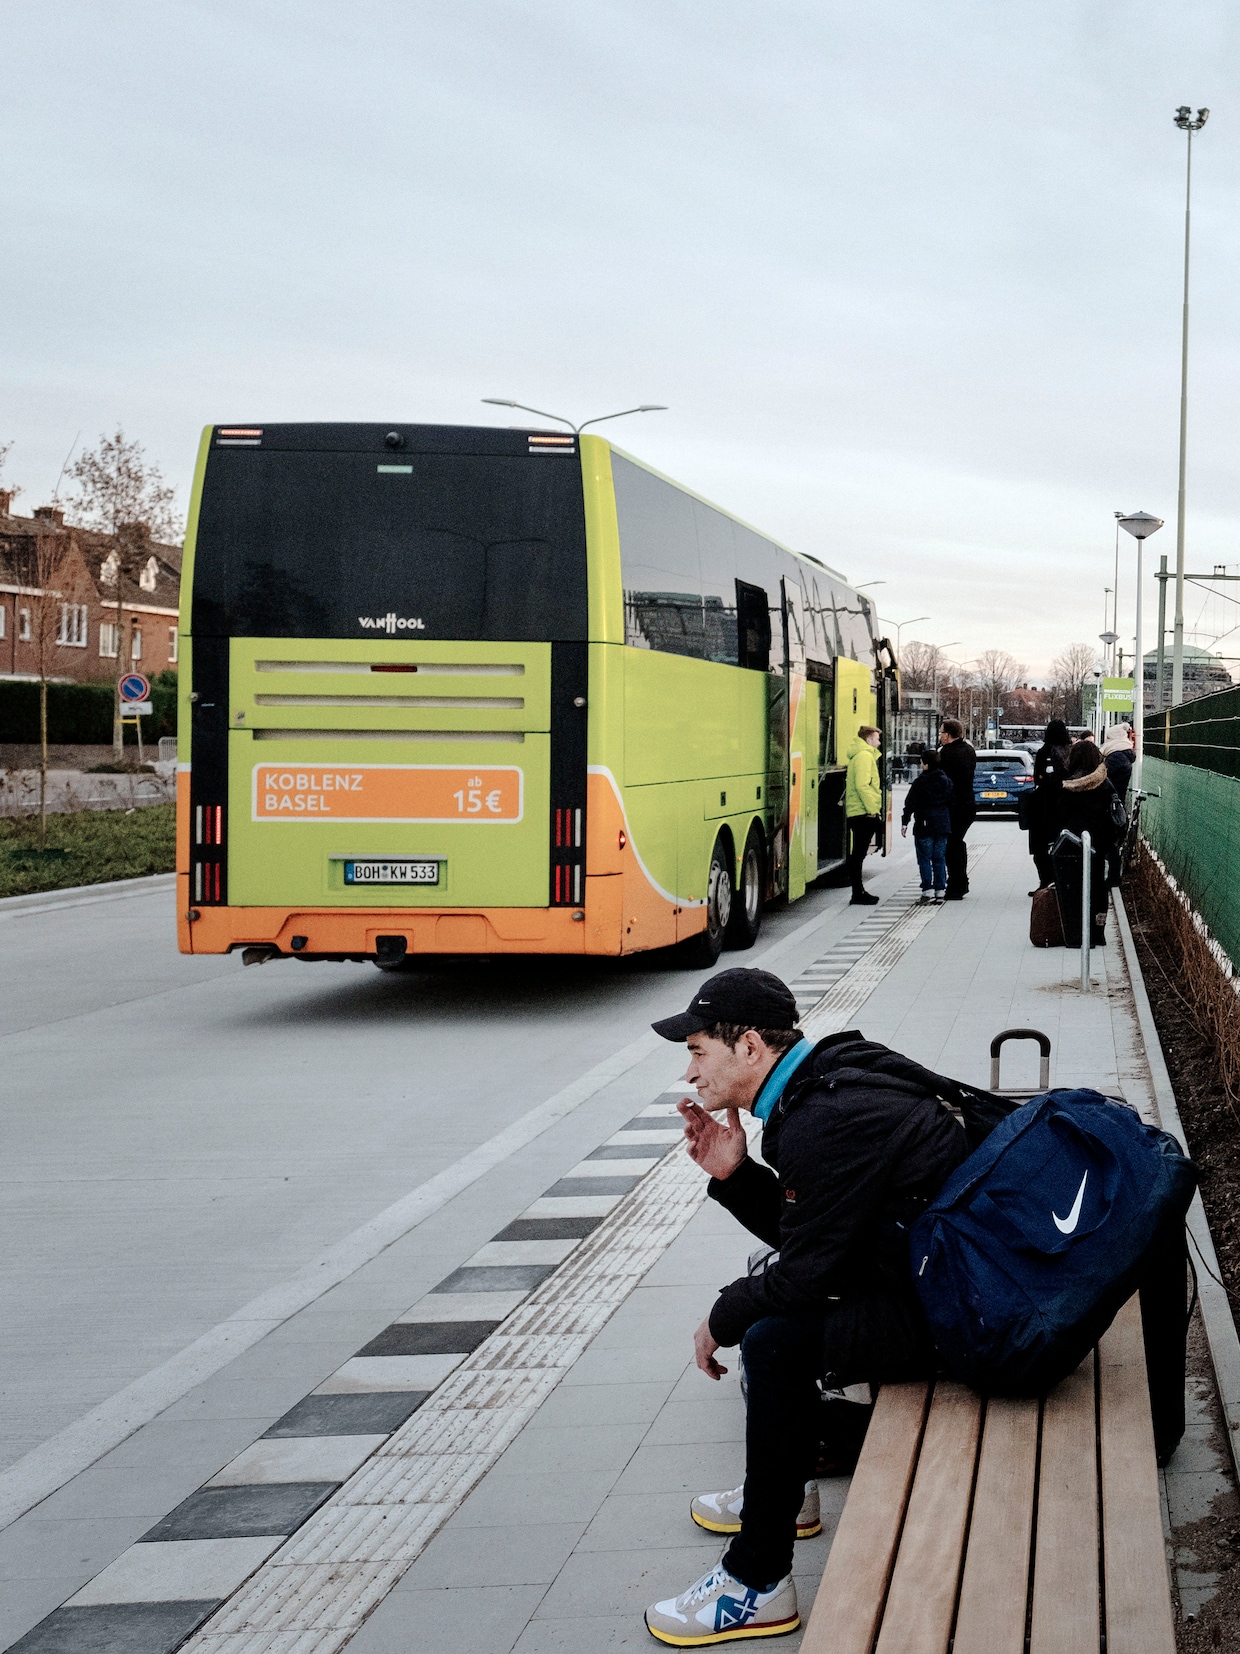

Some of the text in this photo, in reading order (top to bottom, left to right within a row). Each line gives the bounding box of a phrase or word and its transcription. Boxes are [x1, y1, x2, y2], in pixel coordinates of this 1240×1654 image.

[265, 773, 363, 791] KOBLENZ
[467, 776, 482, 788] ab
[265, 794, 331, 812] BASEL
[355, 865, 435, 879] BOH KW 533
